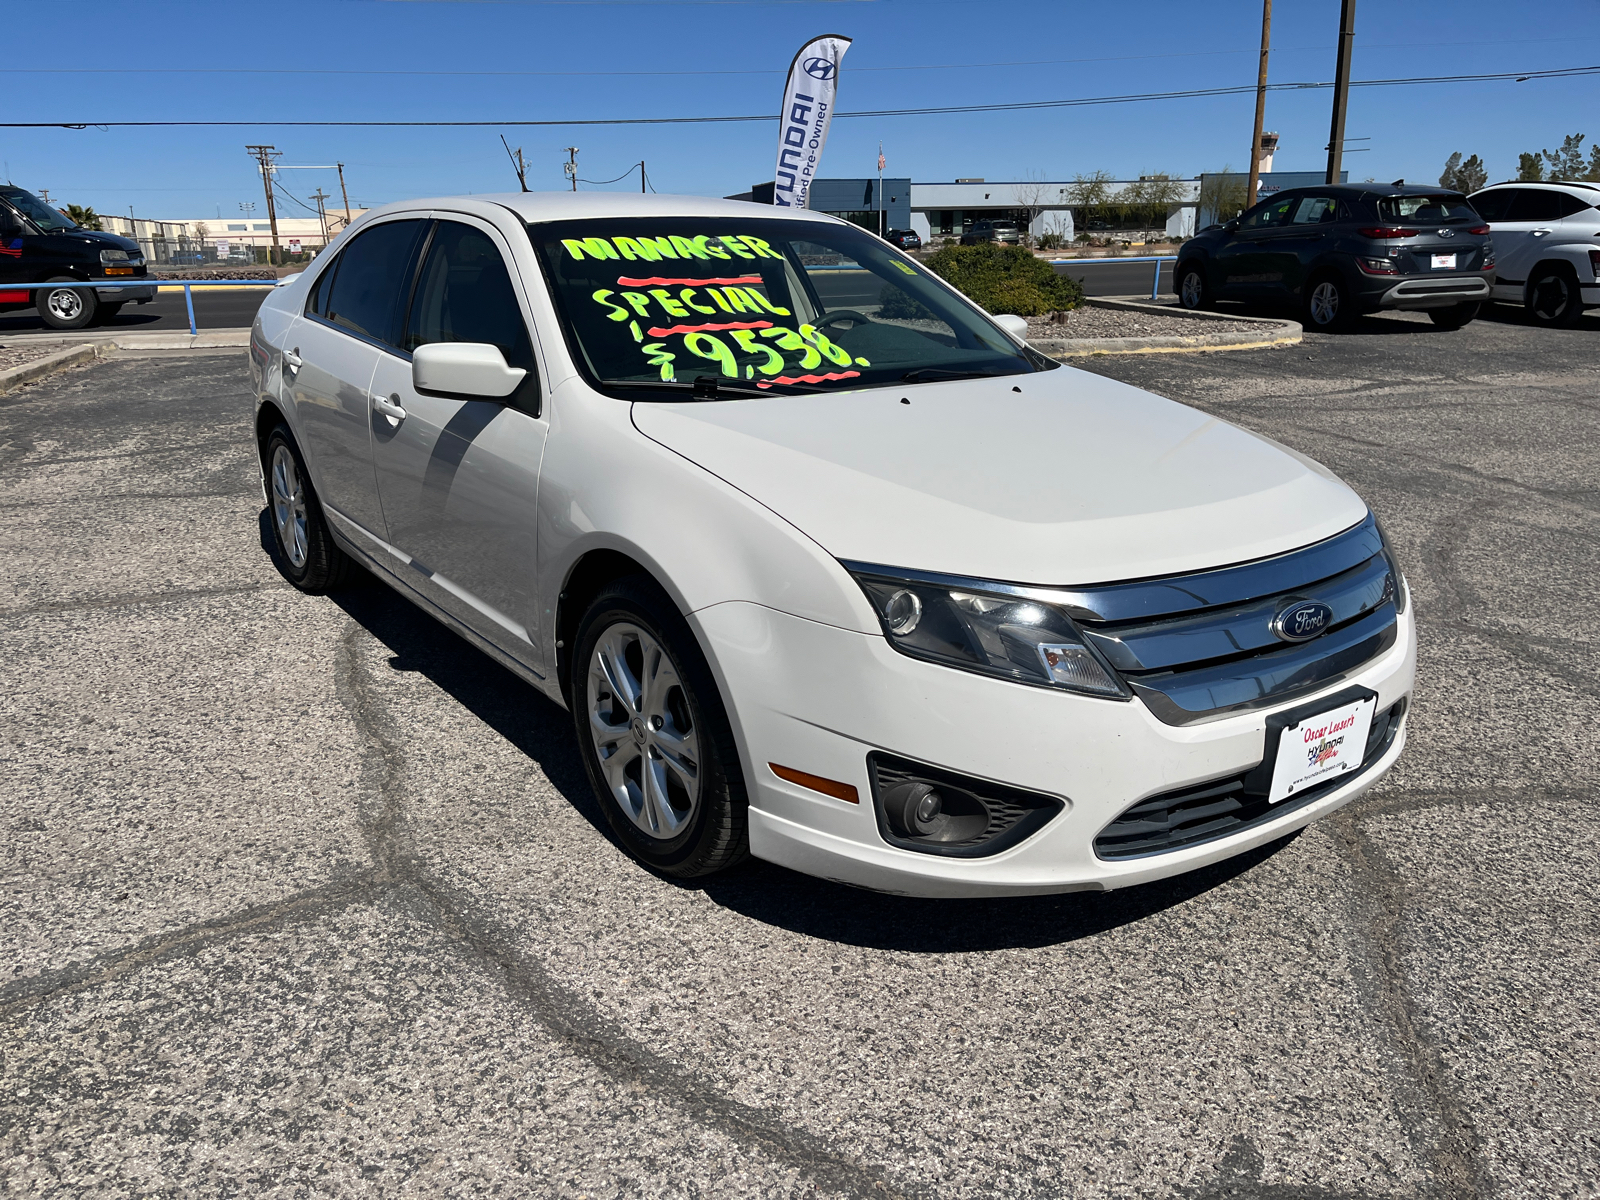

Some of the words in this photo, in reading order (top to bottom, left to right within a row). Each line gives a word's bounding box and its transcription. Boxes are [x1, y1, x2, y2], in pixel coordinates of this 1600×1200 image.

[776, 93, 814, 207] YUNDAI
[803, 102, 828, 177] Pre-Owned
[561, 235, 786, 261] MANAGER
[1295, 607, 1324, 633] Ford
[1304, 727, 1328, 743] Oscar
[1308, 735, 1344, 757] HYUNDAI
